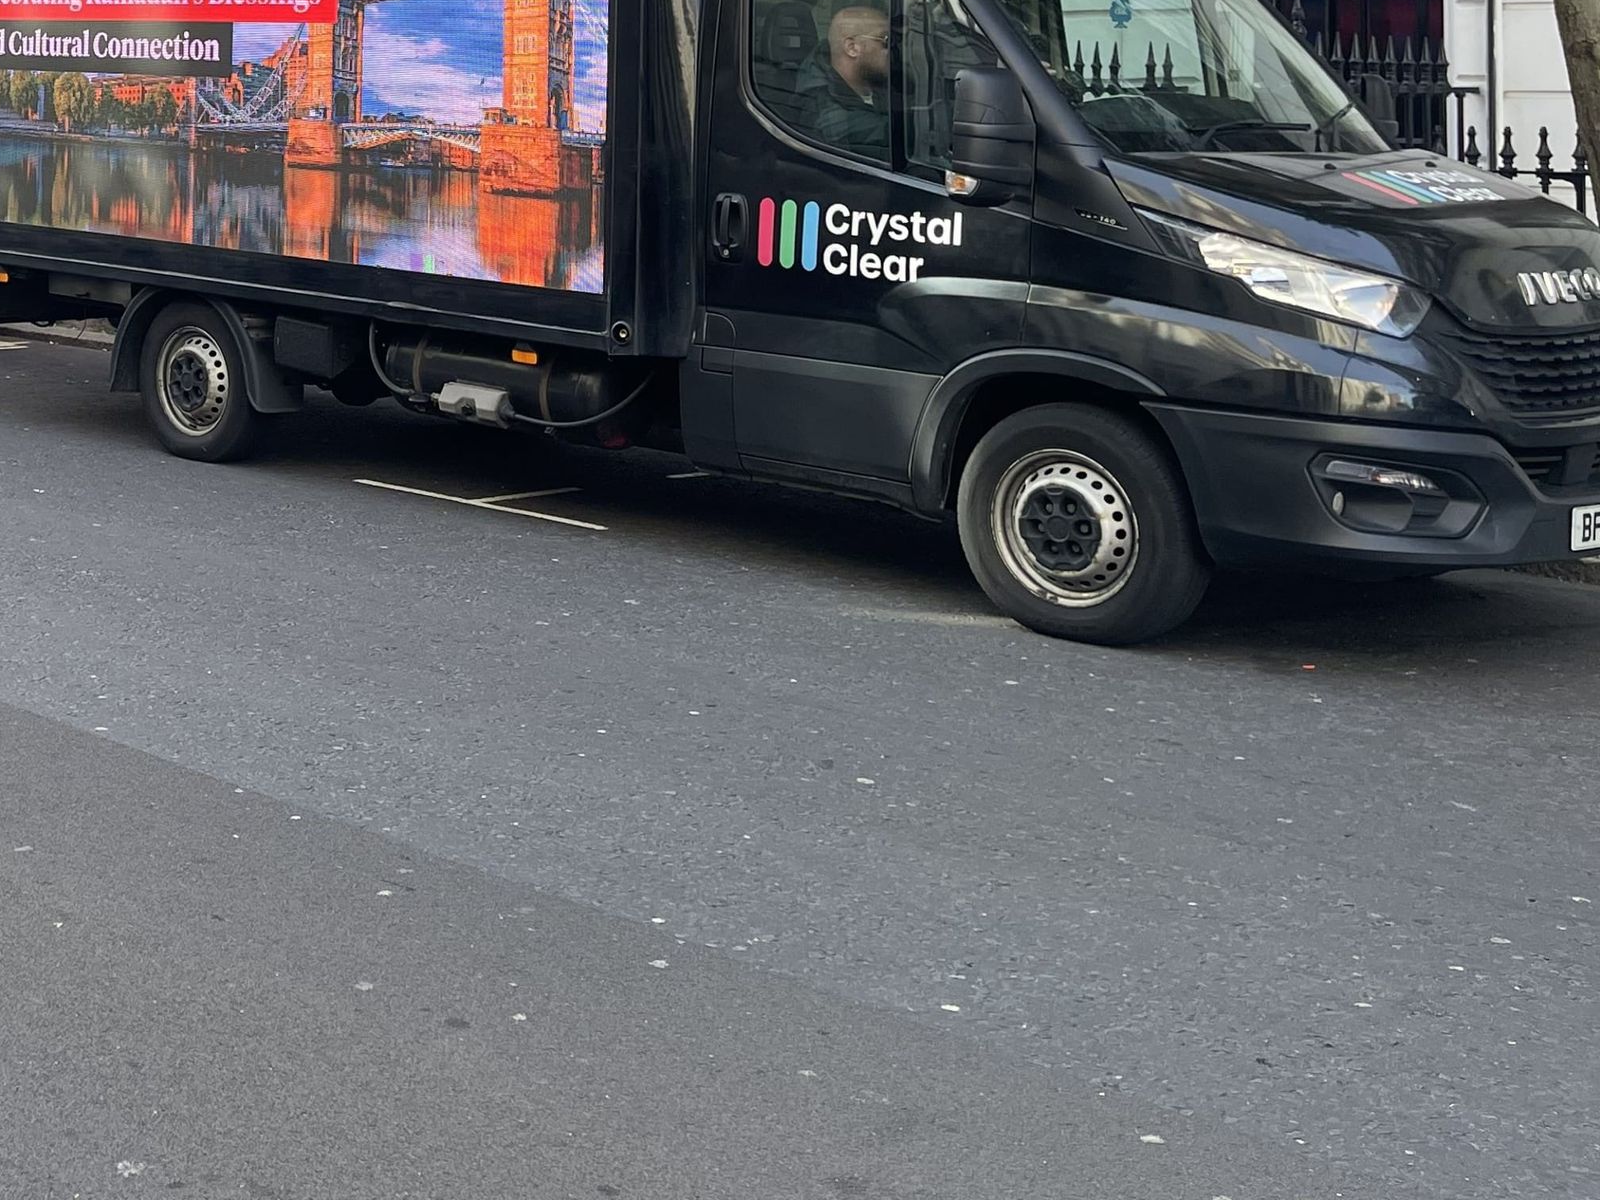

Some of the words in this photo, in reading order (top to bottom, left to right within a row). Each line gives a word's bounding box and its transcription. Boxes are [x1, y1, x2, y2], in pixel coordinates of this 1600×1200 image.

[8, 29, 90, 58] Cultural
[93, 31, 221, 62] Connection
[825, 203, 963, 246] Crystal
[822, 243, 924, 283] Clear
